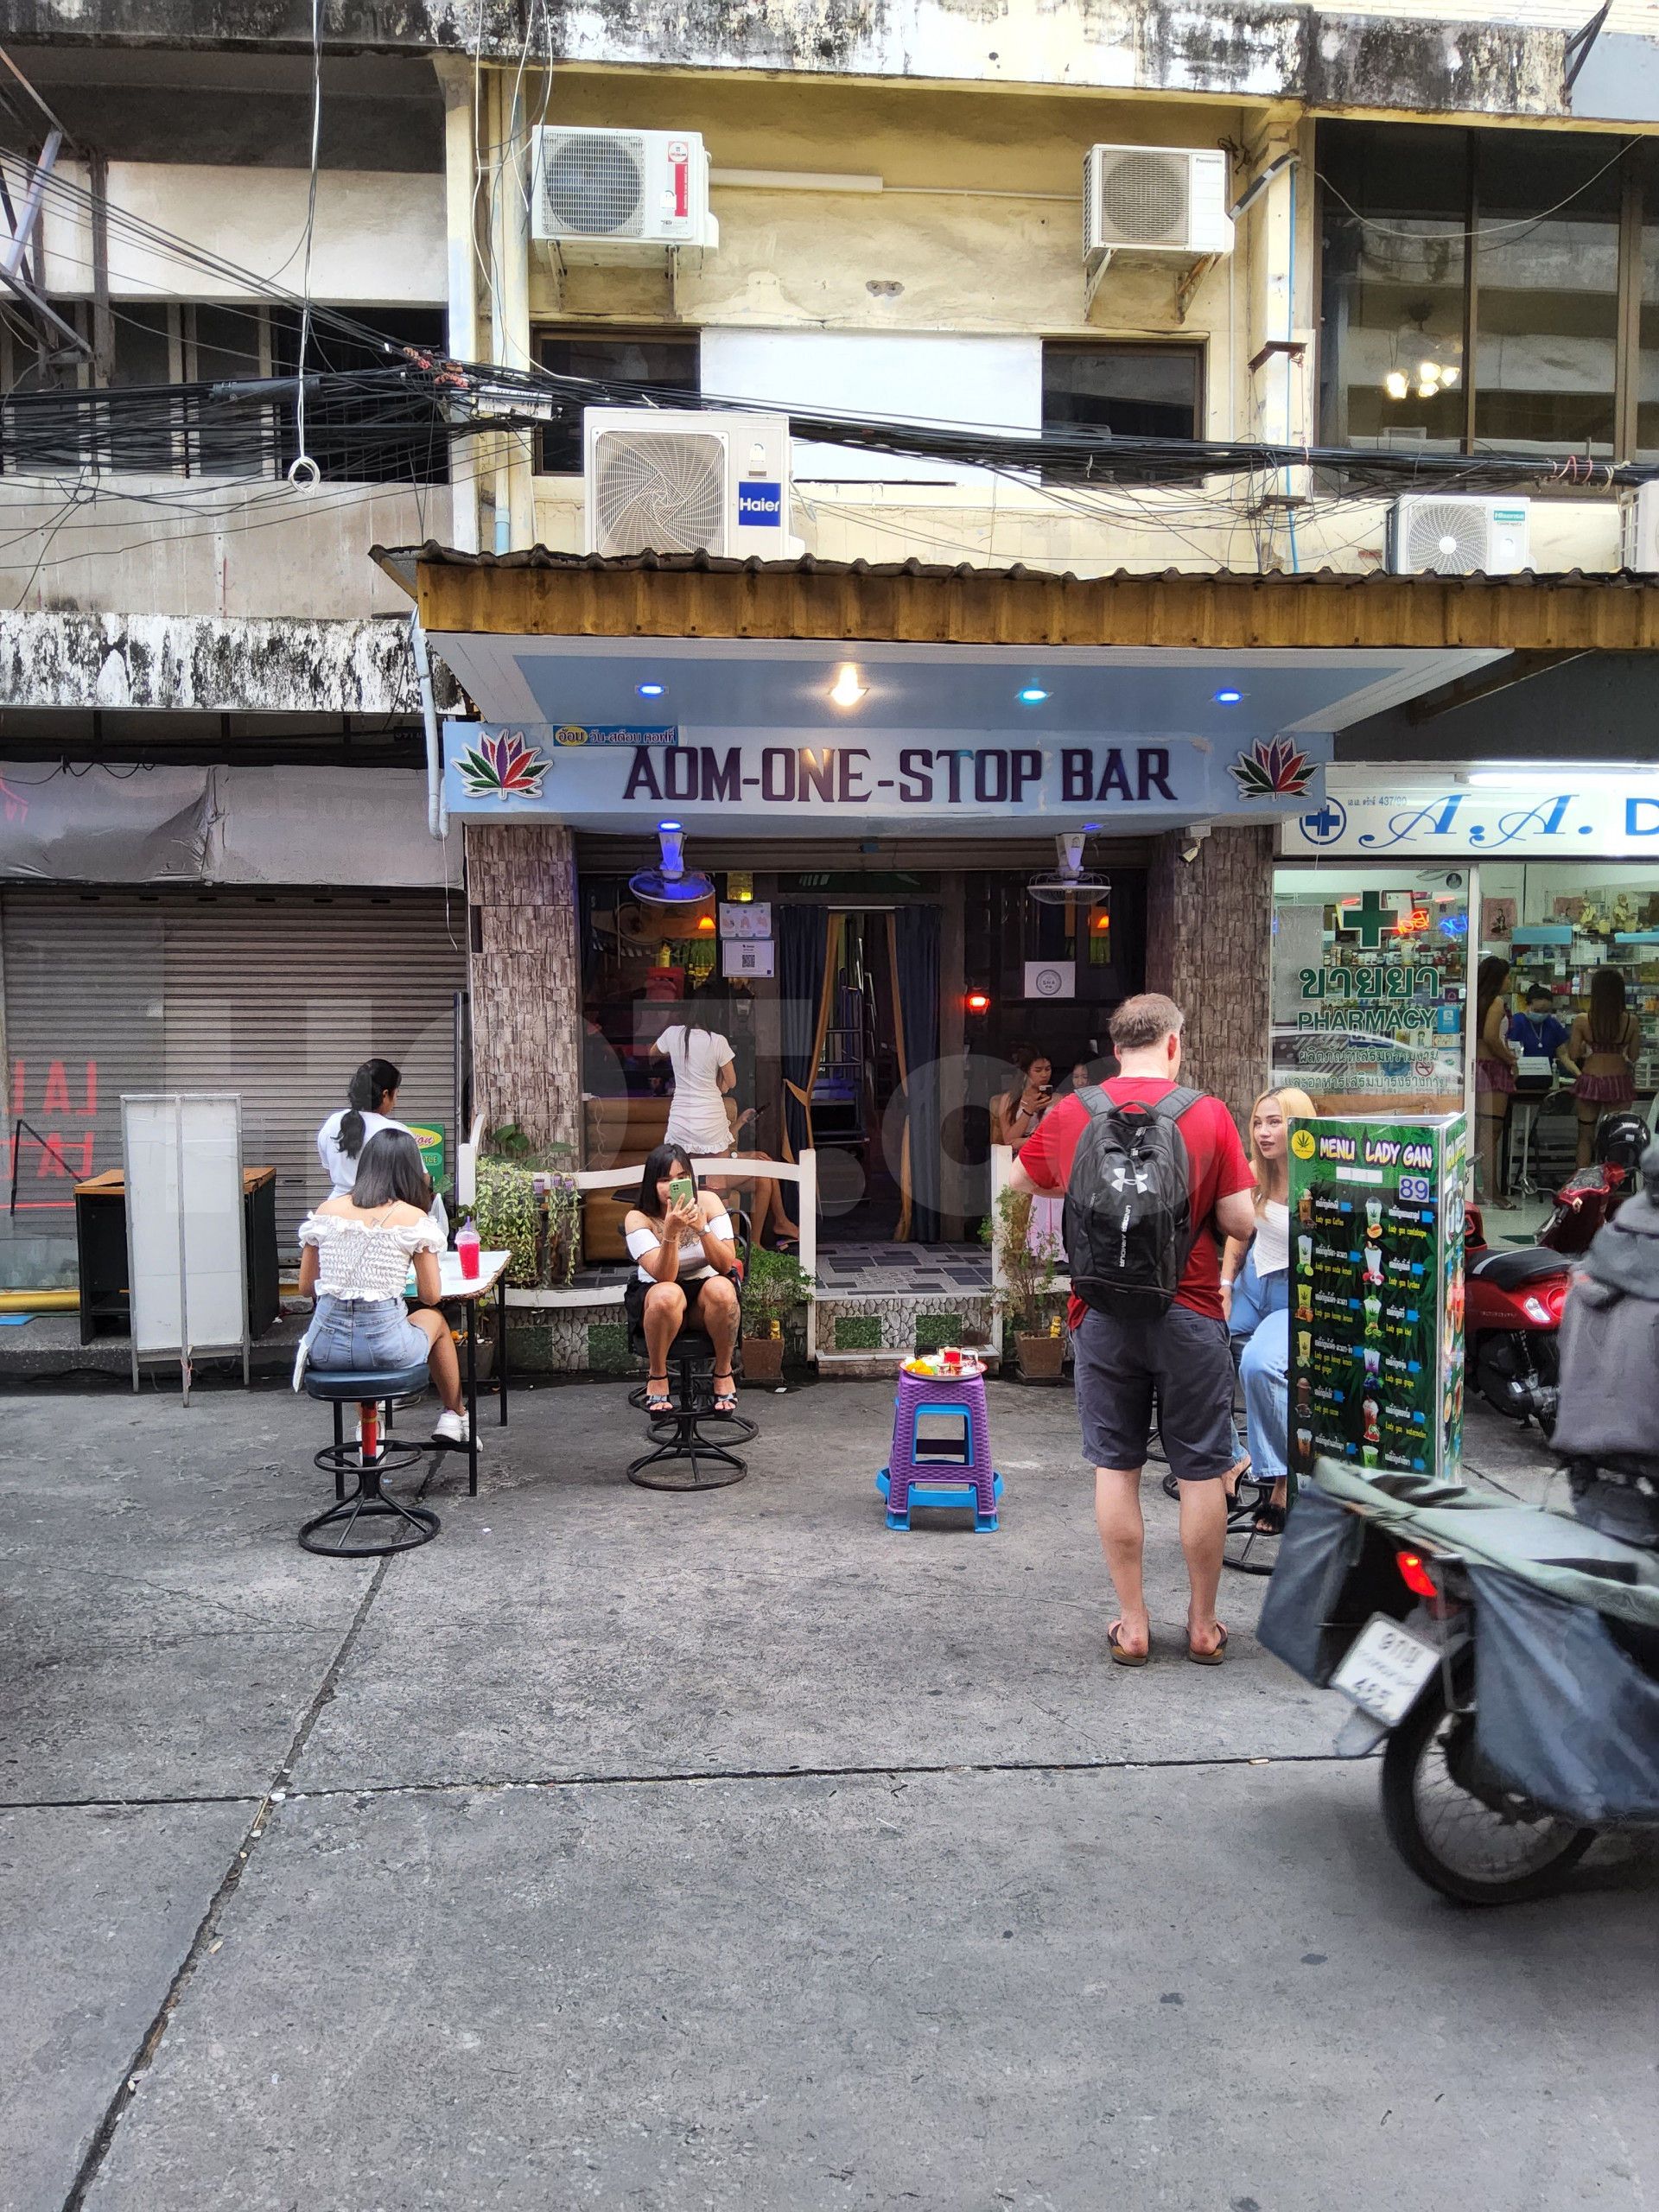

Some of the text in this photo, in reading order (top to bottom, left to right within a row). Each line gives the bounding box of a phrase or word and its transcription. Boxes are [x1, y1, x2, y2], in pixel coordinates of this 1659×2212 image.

[740, 497, 780, 512] Haier
[622, 746, 1178, 803] AOM-ONE-STOP BAR
[1299, 966, 1440, 1000] ขายยา
[1298, 1007, 1437, 1032] PHARMACY
[1320, 1137, 1355, 1160] MENU
[1366, 1141, 1400, 1166] LADY
[1403, 1144, 1433, 1168] GAN
[1400, 1178, 1428, 1200] 89
